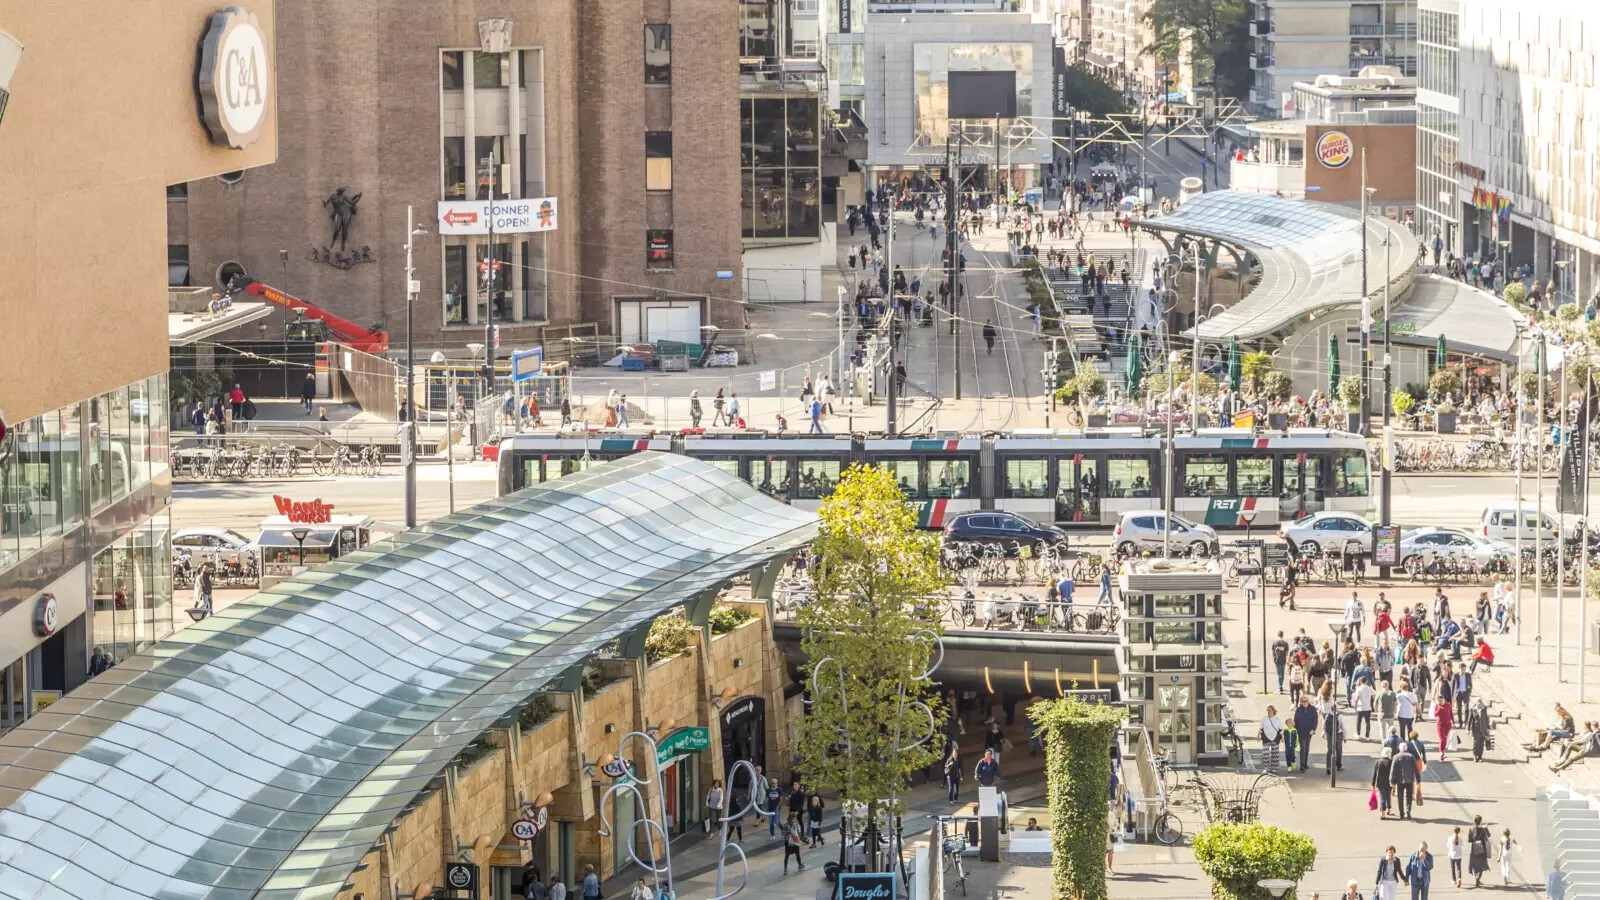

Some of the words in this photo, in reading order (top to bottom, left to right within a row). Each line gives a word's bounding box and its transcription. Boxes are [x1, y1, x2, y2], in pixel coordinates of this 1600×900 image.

[225, 46, 262, 109] C&A
[1320, 139, 1348, 151] BURGER
[1321, 145, 1349, 160] KING
[484, 205, 529, 216] DONNER
[497, 218, 529, 228] OPEN!
[1213, 500, 1237, 509] RET
[515, 825, 534, 835] C&A
[845, 884, 890, 900] Douglas
